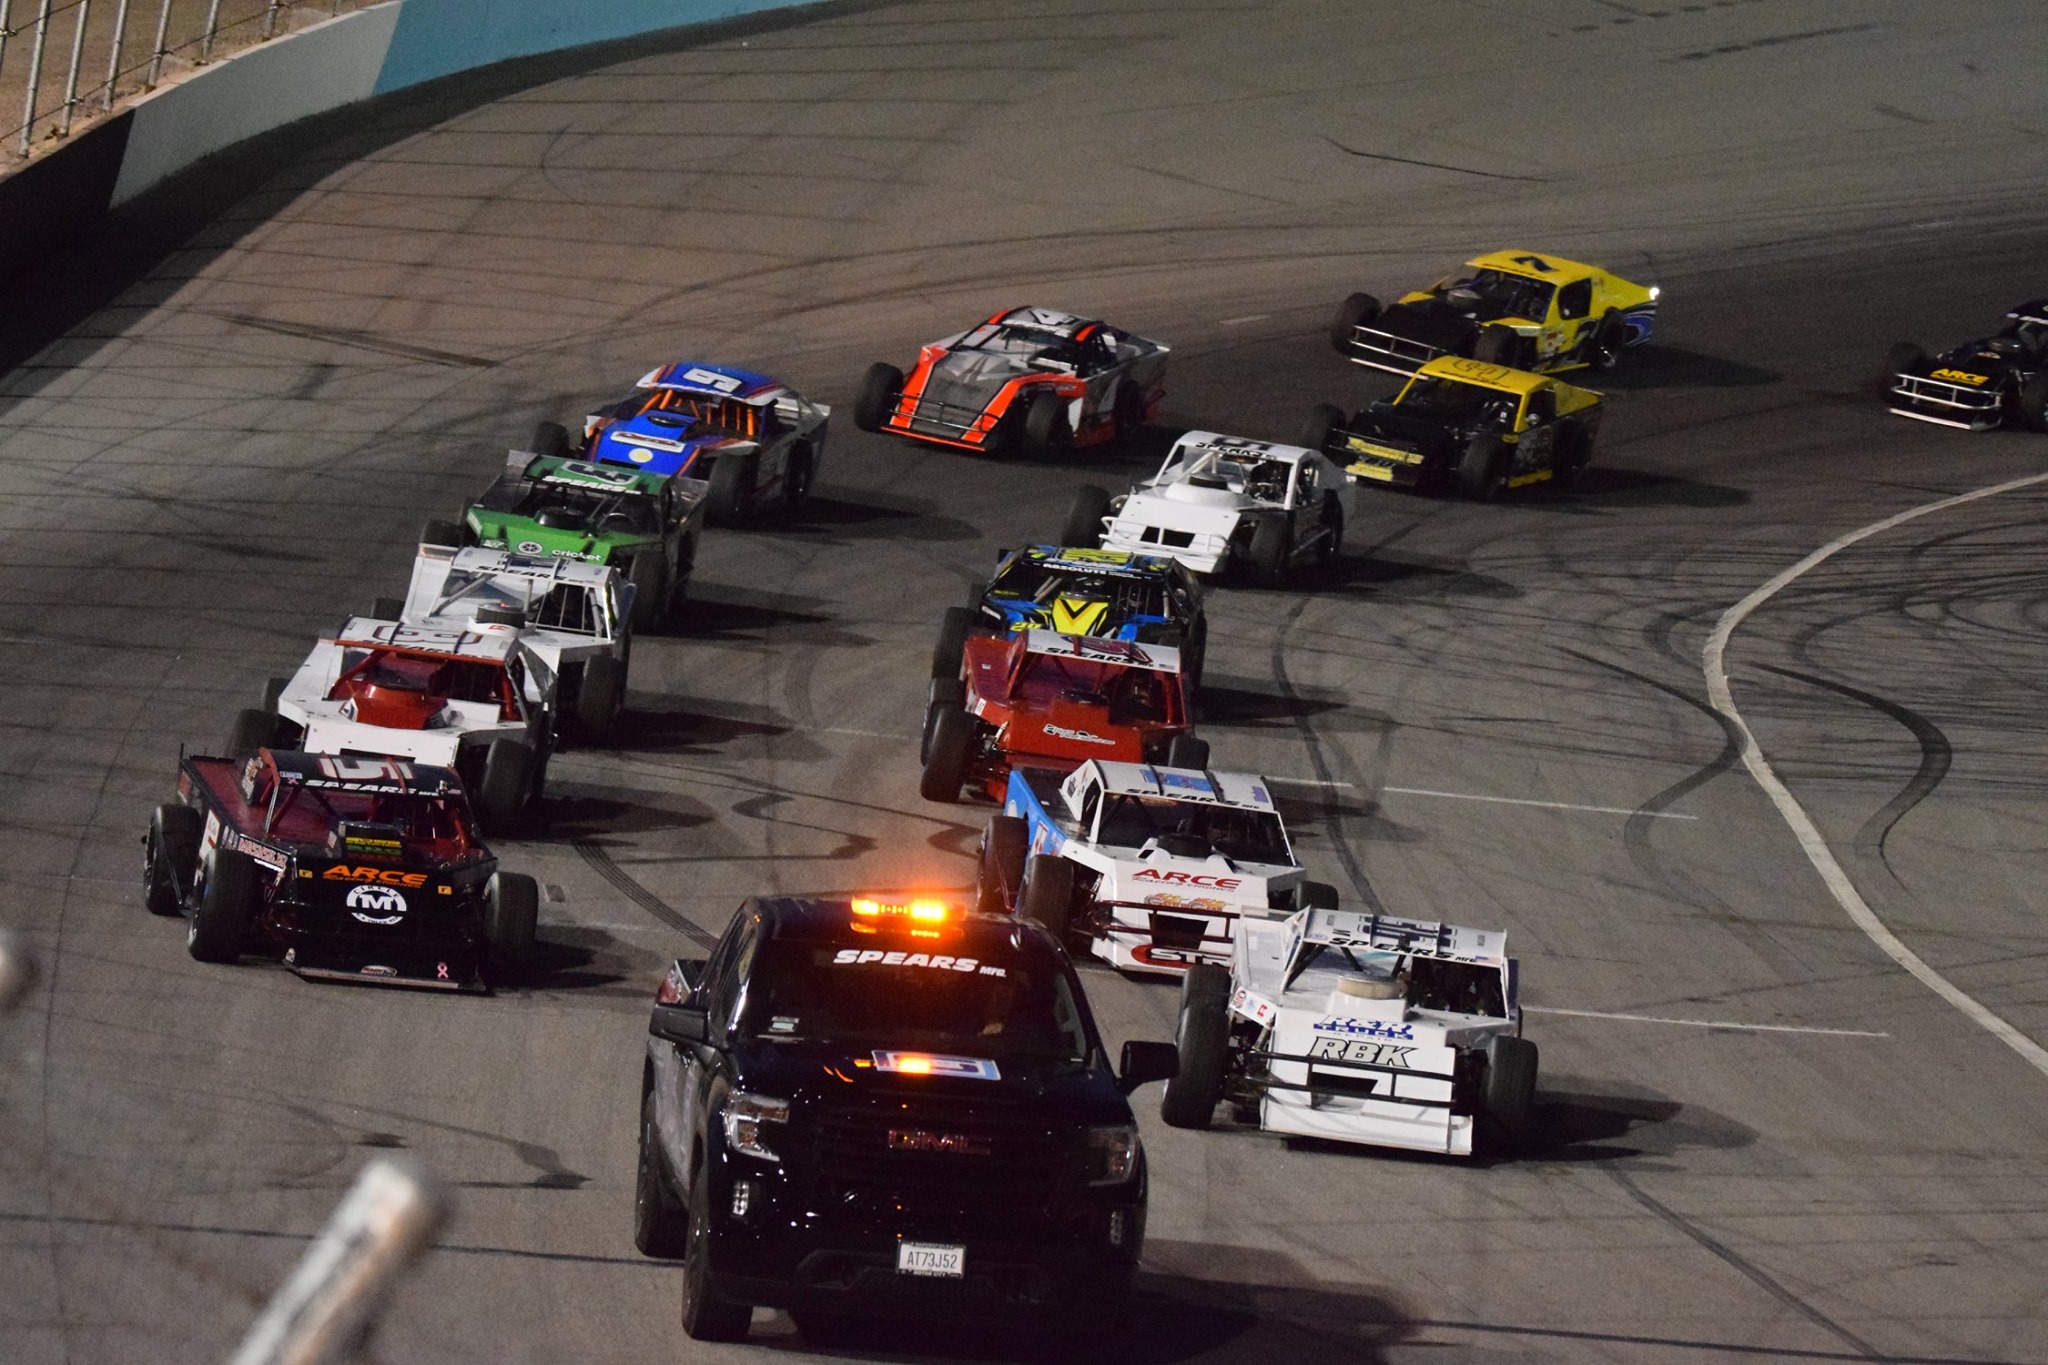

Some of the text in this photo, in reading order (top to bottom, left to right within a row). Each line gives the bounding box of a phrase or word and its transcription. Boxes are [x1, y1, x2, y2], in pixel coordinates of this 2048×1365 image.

[542, 475, 626, 493] SPEARS
[552, 549, 602, 561] cricket
[305, 779, 416, 795] SPEARS
[322, 864, 428, 885] ARCE
[1132, 868, 1242, 889] ARCE
[353, 885, 400, 899] CIRCLE
[359, 894, 394, 911] M
[1329, 937, 1454, 959] SPEARS
[833, 949, 1007, 978] SPEARS MFG.
[1306, 1035, 1419, 1068] RBK
[906, 1250, 958, 1269] AT73J52
